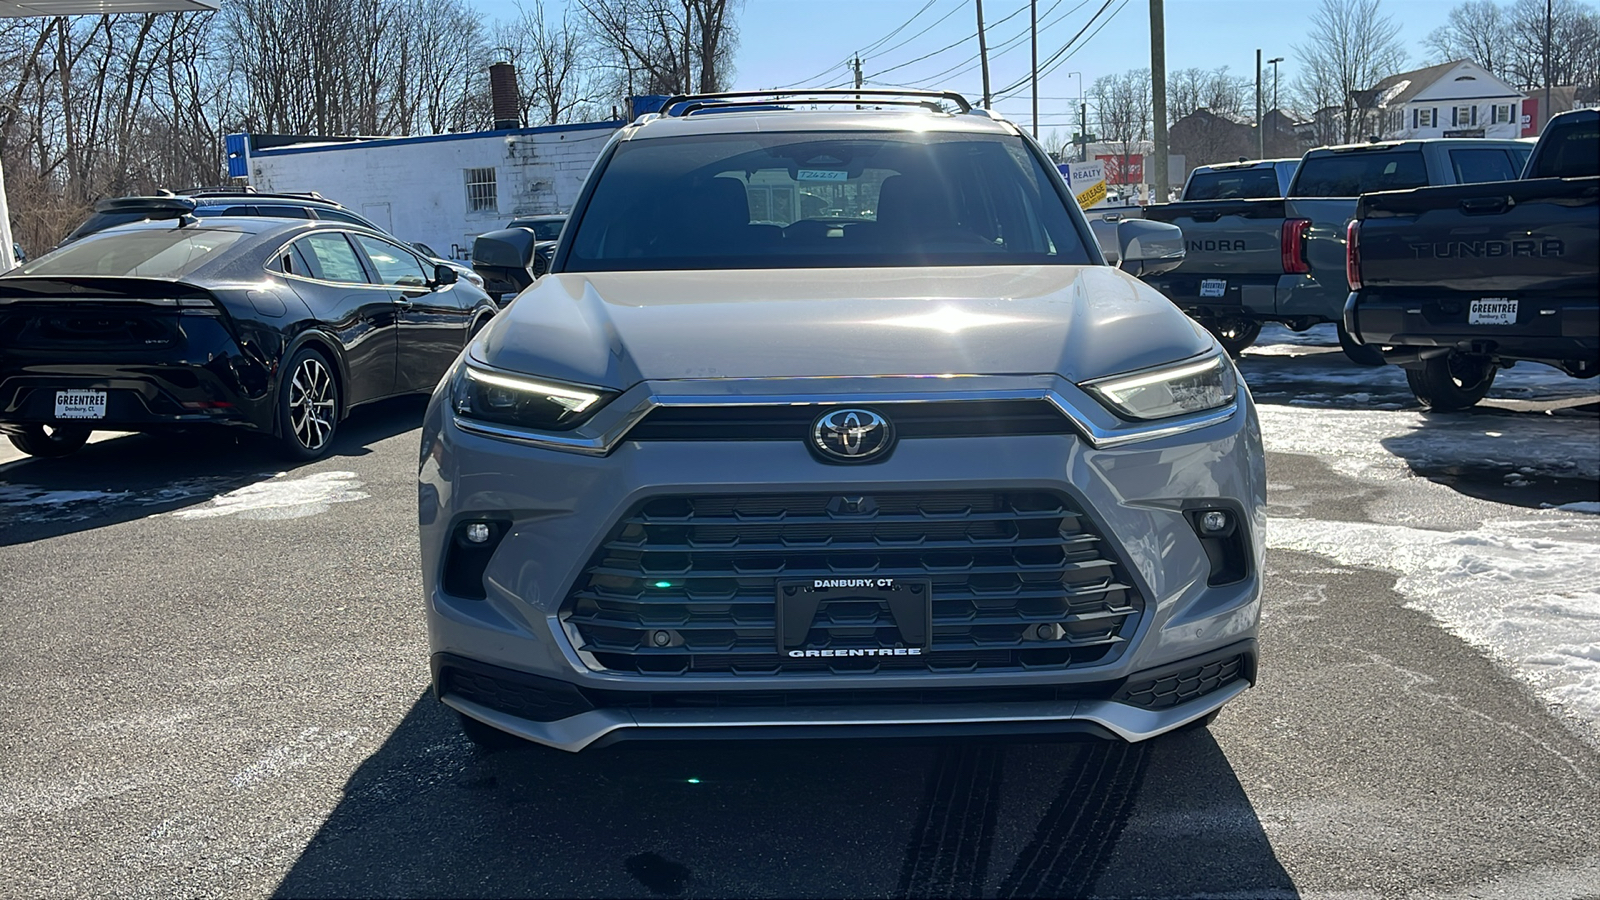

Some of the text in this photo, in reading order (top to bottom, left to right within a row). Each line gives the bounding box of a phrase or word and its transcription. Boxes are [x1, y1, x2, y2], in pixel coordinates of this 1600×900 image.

[1073, 168, 1101, 180] REALTY
[1077, 184, 1105, 204] ALE/LEASE
[1409, 239, 1565, 259] TUNDRA
[1472, 303, 1517, 313] GREENTREE
[57, 395, 105, 405] GREENTREE
[814, 578, 893, 588] DANBURY, CT
[788, 648, 922, 658] GREENTREE
